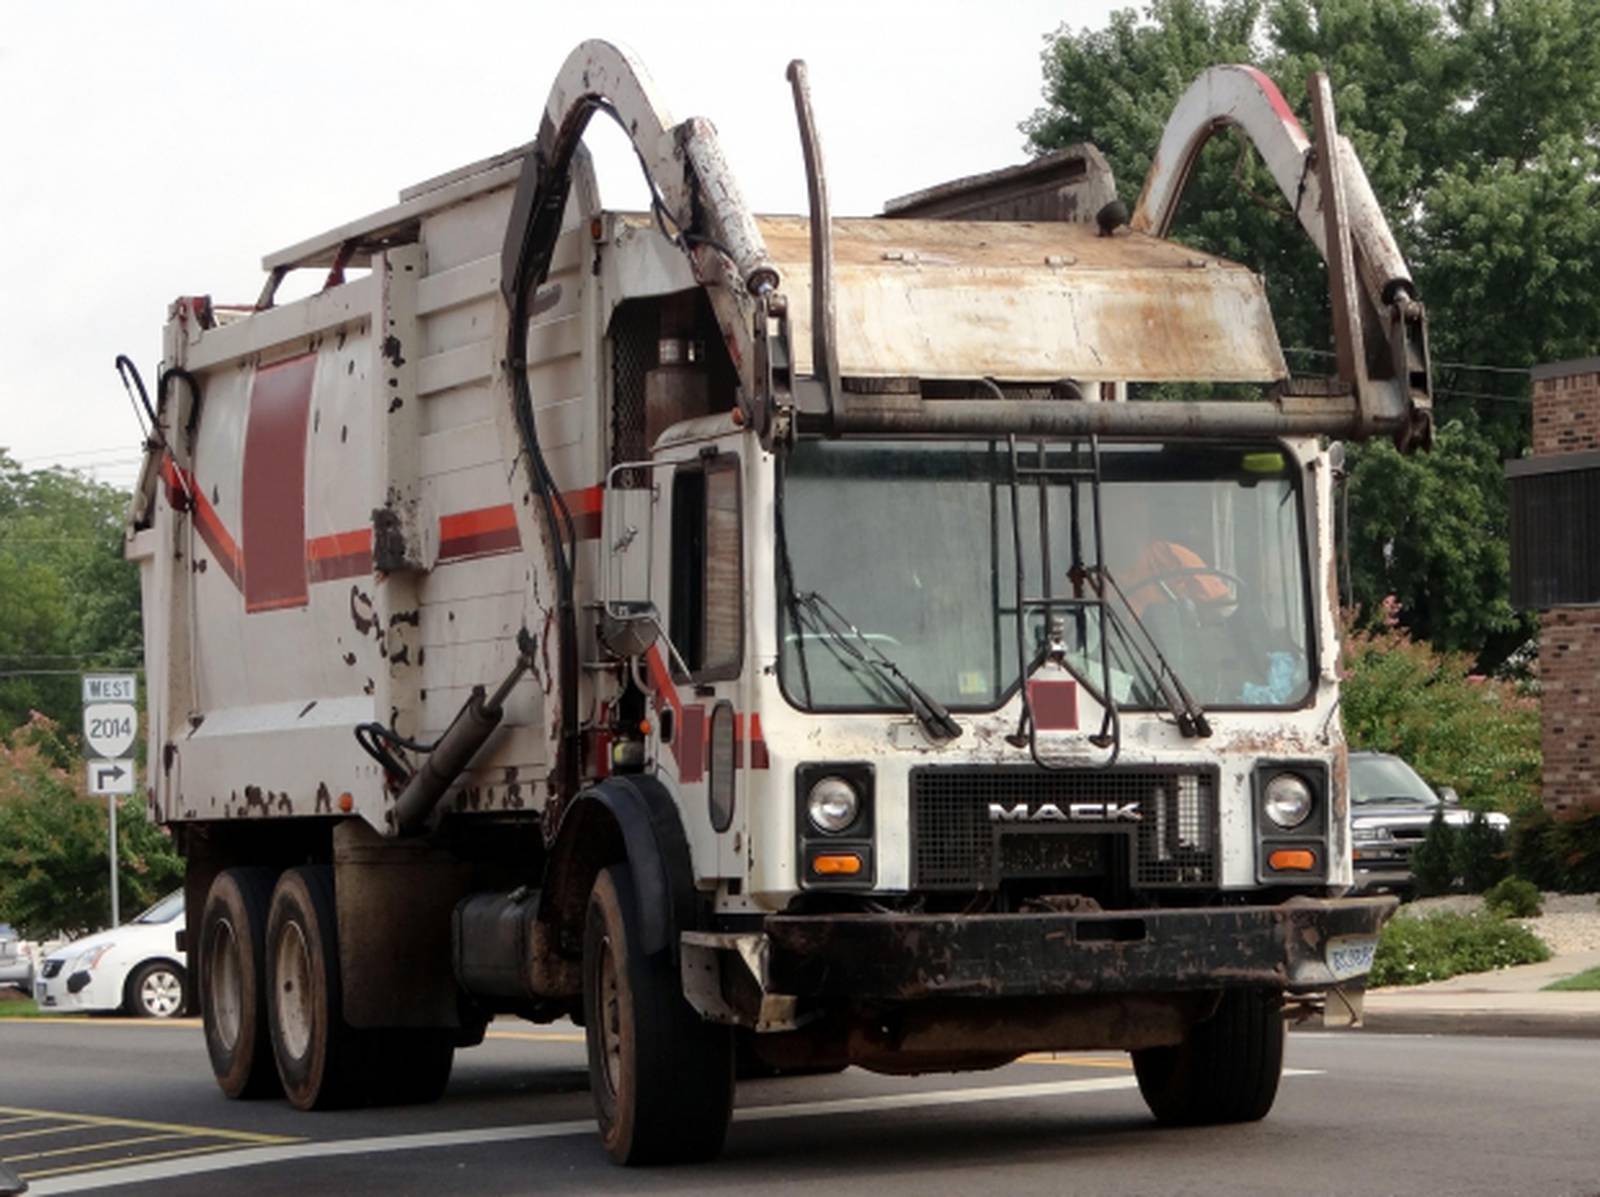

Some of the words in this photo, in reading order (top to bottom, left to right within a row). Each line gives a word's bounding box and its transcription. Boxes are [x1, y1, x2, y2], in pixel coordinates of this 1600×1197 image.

[88, 680, 131, 697] WEST
[90, 717, 132, 738] 2014
[988, 803, 1143, 820] MACK
